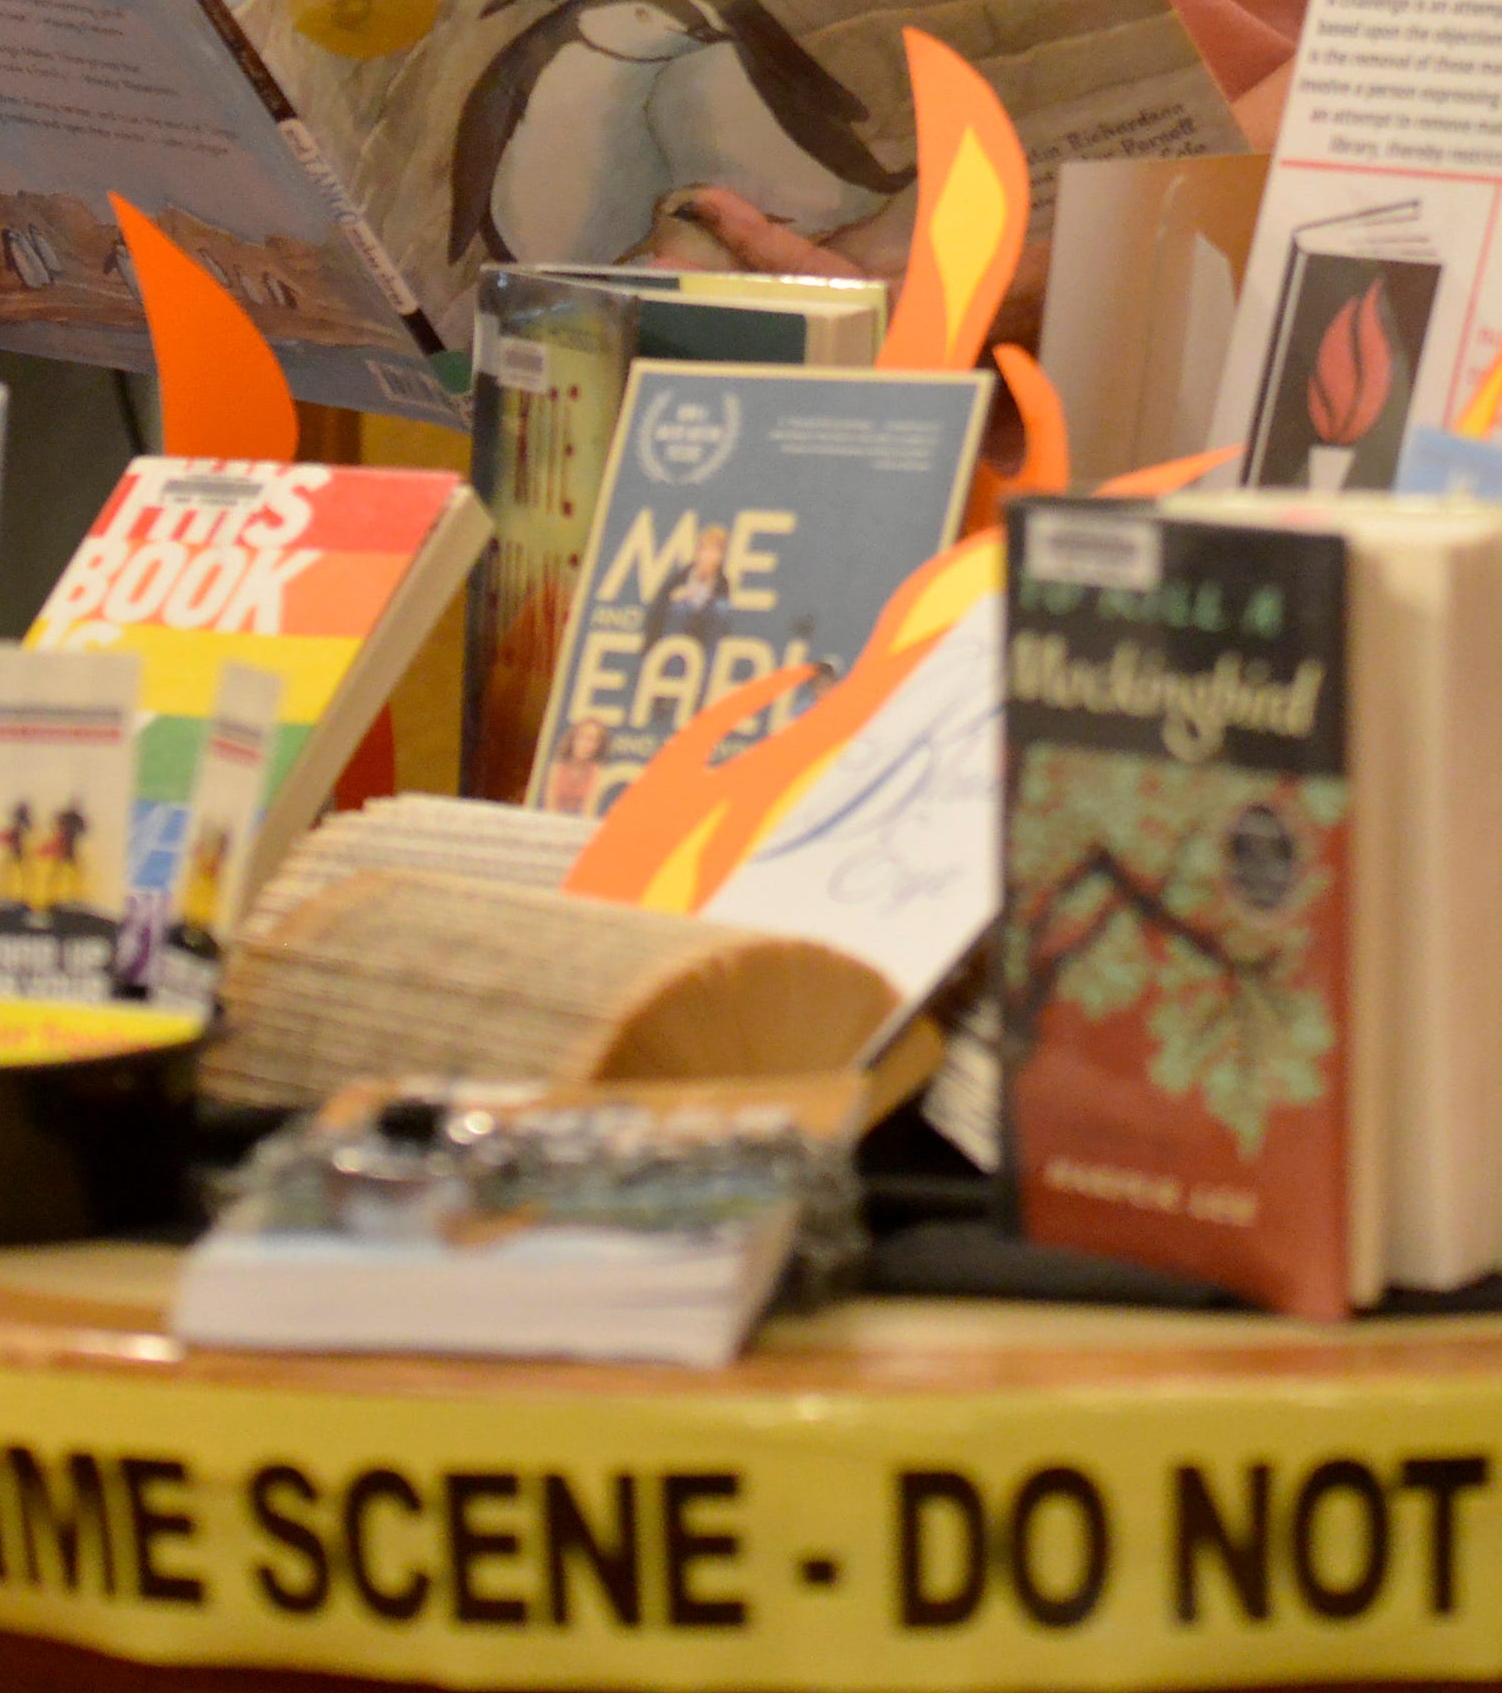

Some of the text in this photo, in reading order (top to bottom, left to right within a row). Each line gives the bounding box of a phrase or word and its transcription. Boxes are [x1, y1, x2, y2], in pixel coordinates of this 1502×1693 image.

[55, 537, 326, 636] BOOK
[595, 506, 796, 612] ME
[1009, 632, 1326, 761] Mockingbird
[245, 1463, 750, 1631] SCENE
[799, 1554, 841, 1587] -
[897, 1464, 1111, 1631] DO
[1171, 1452, 1491, 1625] NOT
